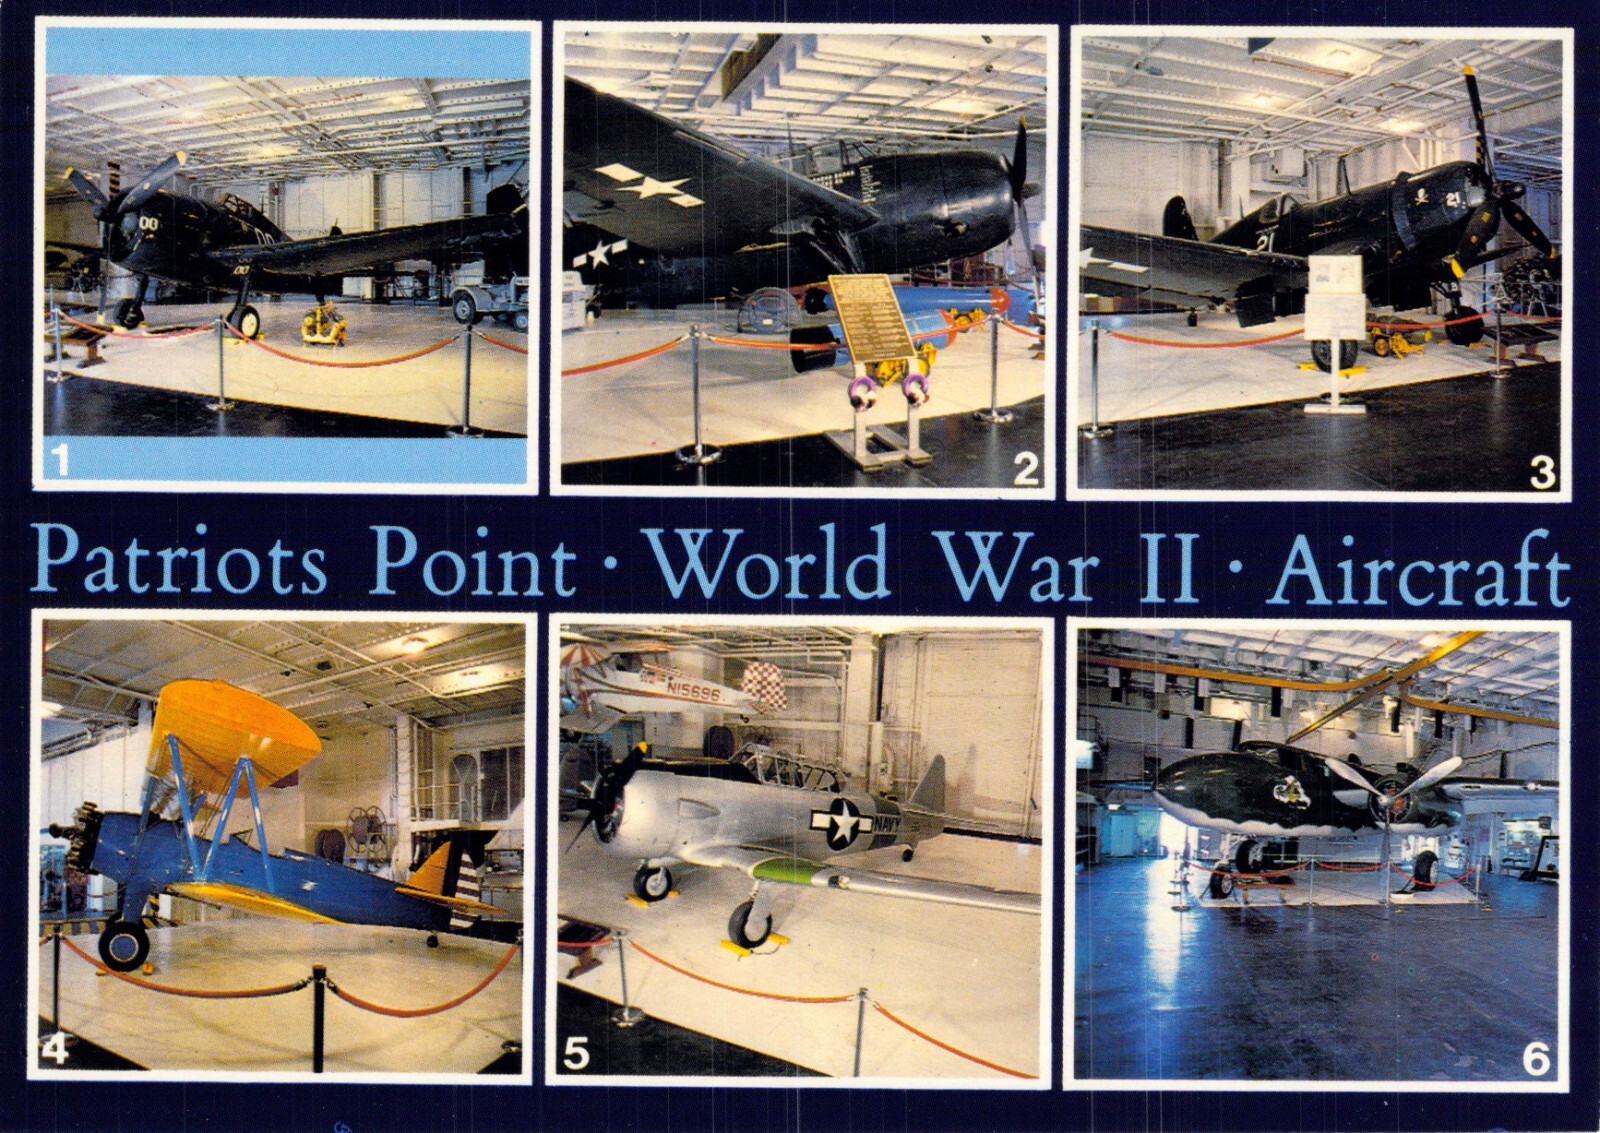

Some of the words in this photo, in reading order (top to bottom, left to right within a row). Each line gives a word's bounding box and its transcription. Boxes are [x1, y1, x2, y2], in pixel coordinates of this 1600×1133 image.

[1446, 191, 1461, 208] 21
[667, 681, 721, 702] N15696
[873, 815, 901, 833] NAVY
